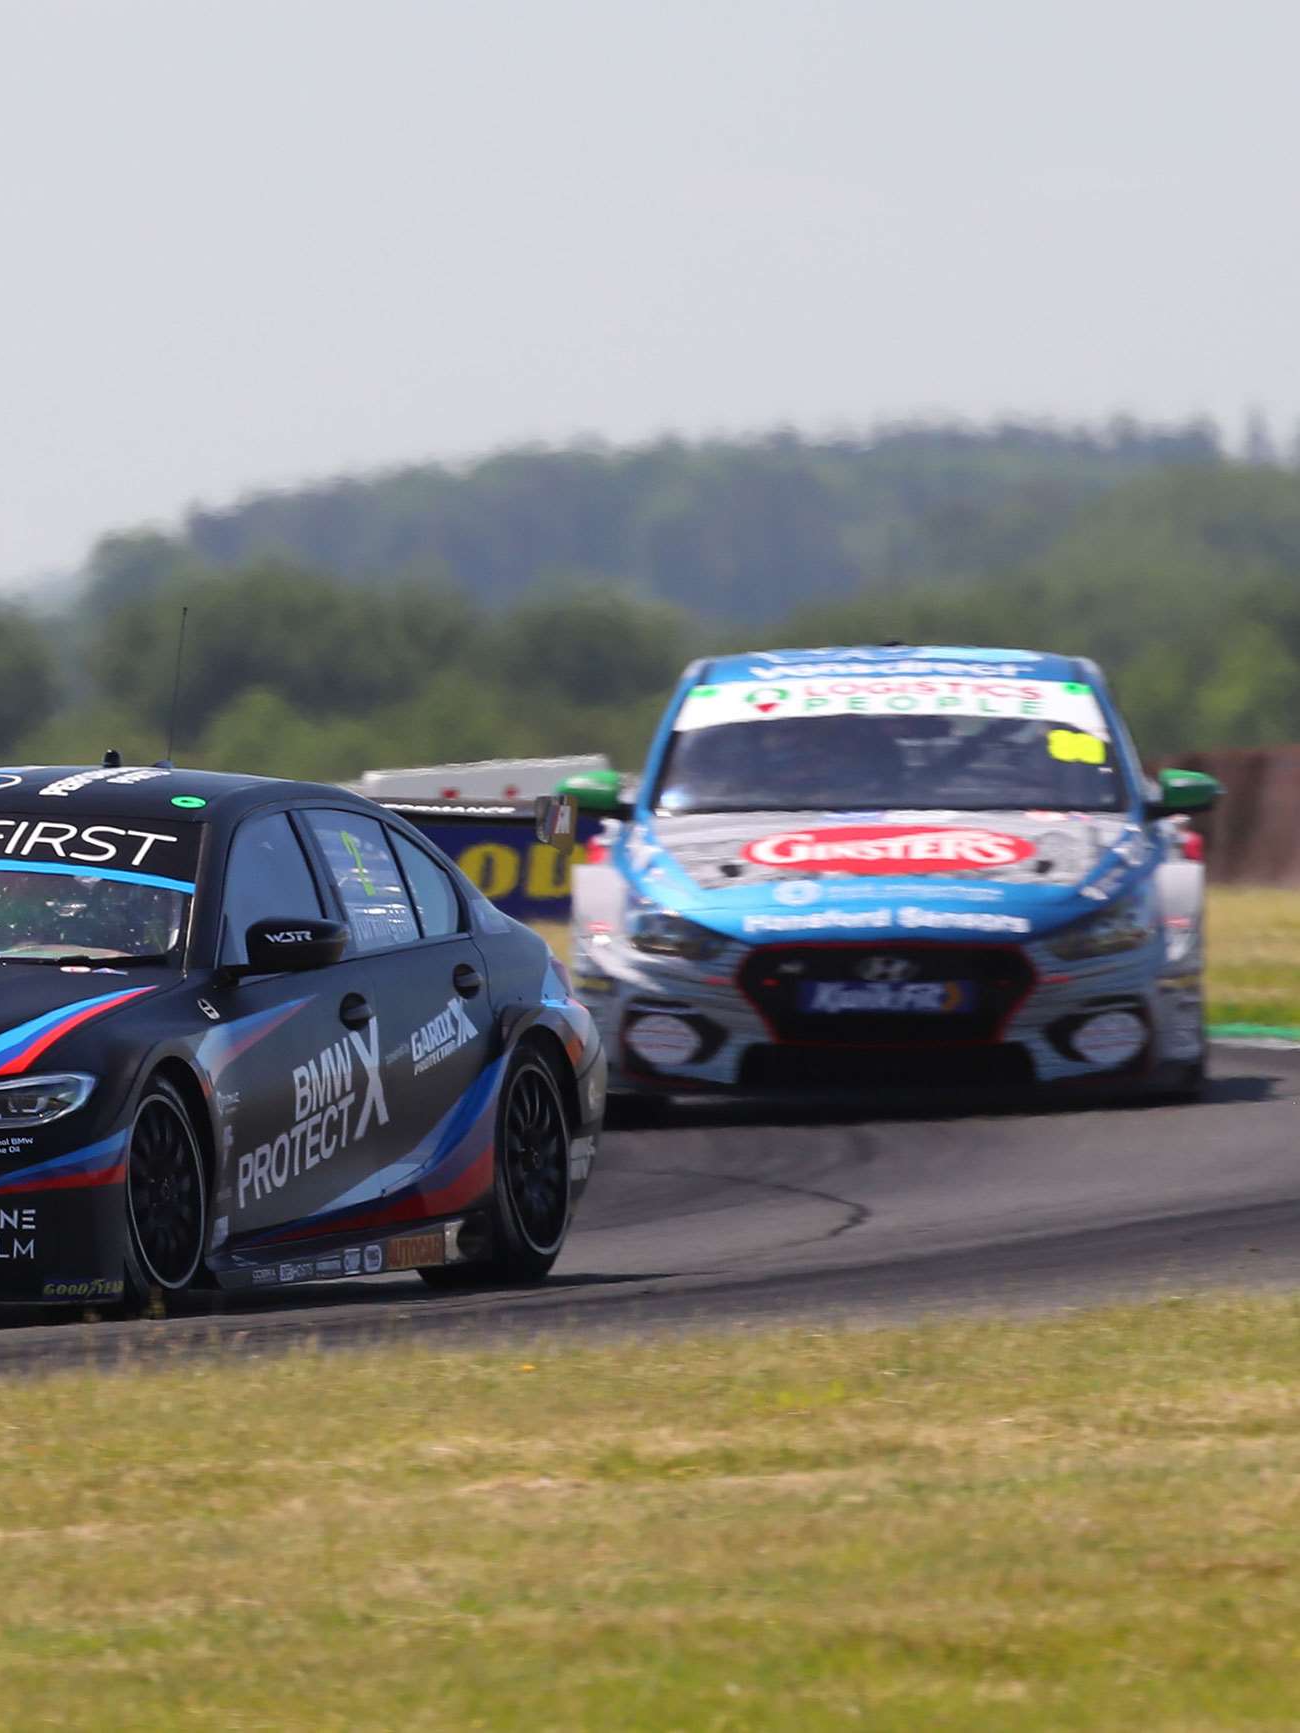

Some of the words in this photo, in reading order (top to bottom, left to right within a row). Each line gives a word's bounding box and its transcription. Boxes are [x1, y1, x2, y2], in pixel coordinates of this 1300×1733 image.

[804, 681, 1042, 700] LOGISTICS
[804, 696, 1045, 715] PEOPLE
[292, 1037, 354, 1121] BMW
[11, 1137, 34, 1145] BMW
[238, 1092, 356, 1209] PROTECT
